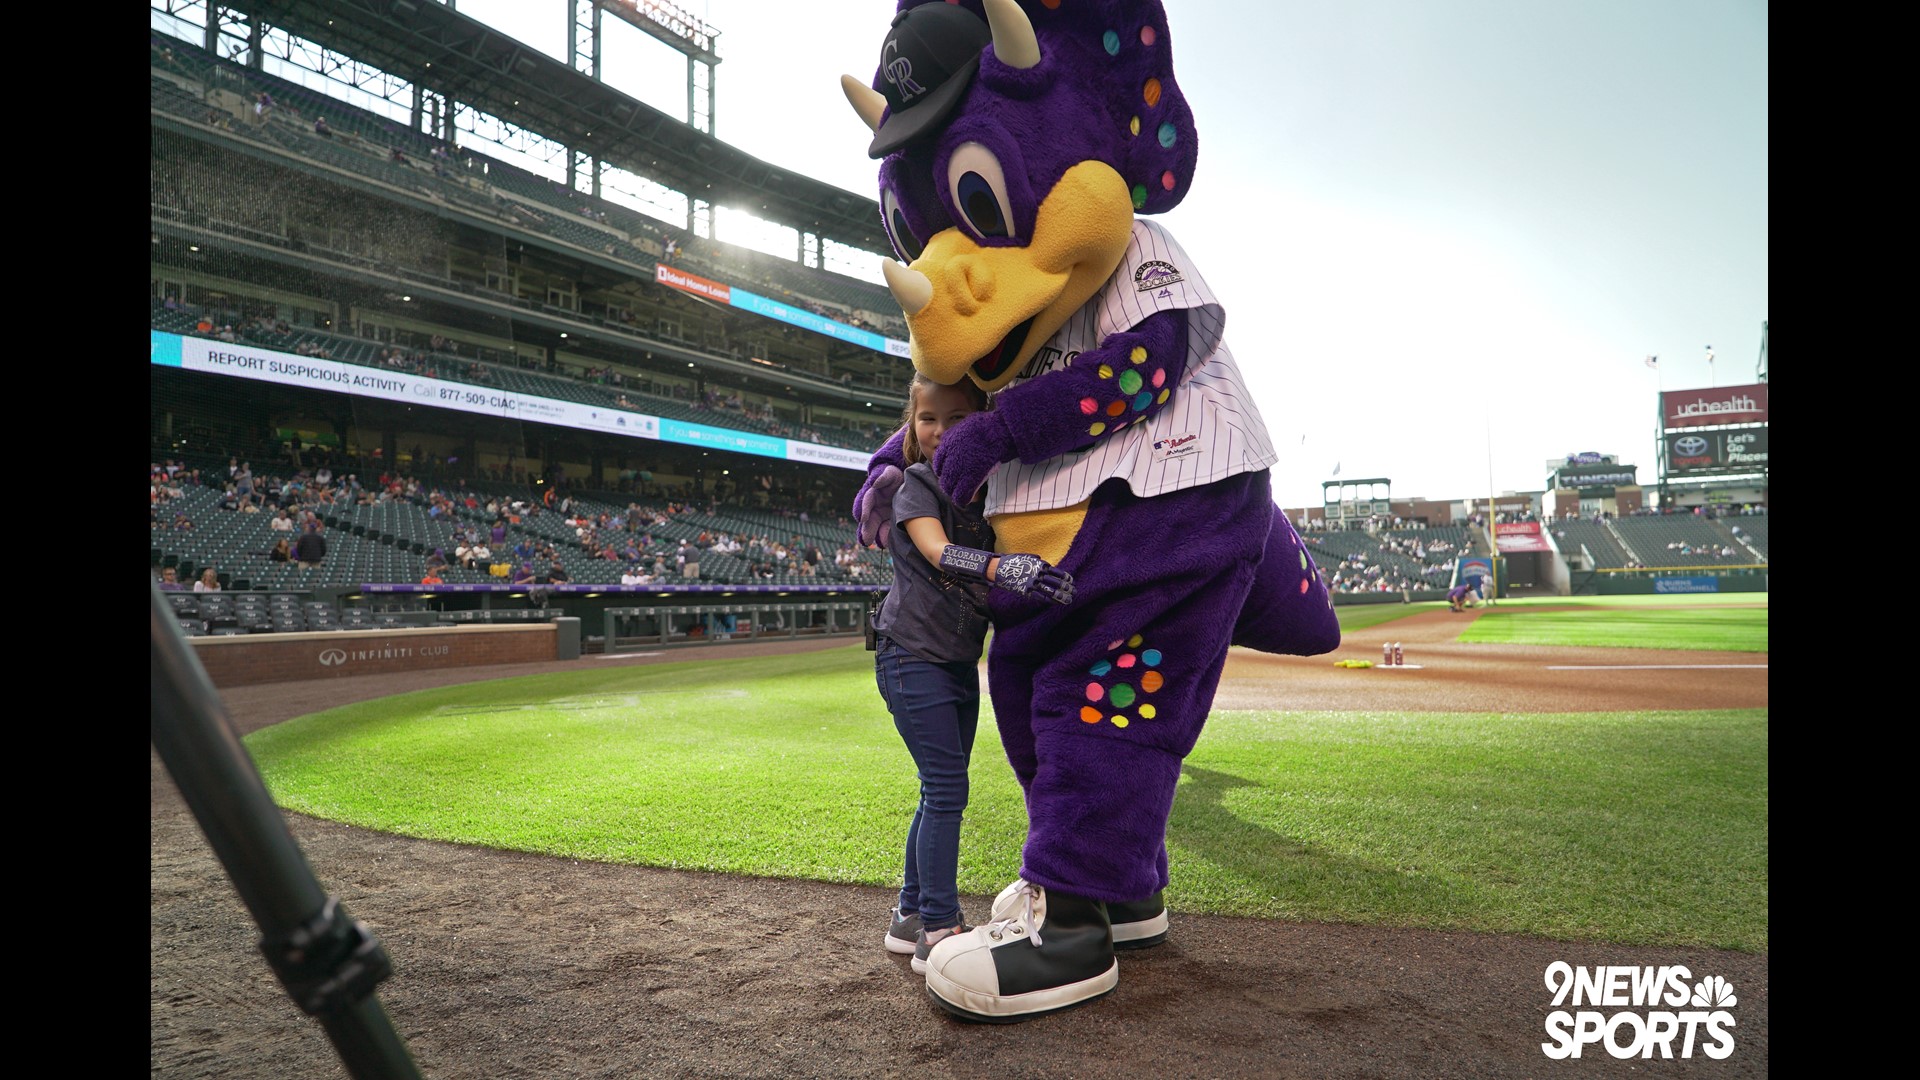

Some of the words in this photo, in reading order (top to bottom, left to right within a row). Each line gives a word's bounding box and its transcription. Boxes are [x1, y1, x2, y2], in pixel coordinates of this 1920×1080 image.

[1136, 261, 1176, 279] COLORADO
[666, 268, 686, 287] Ideal
[686, 277, 708, 294] Home
[708, 283, 730, 300] Loans
[1137, 272, 1182, 290] ROCKIES
[208, 350, 267, 370] REPORT
[269, 361, 350, 384] SUSPICIOUS
[353, 375, 406, 393] ACTIVITY
[413, 383, 437, 398] Call
[440, 387, 516, 410] 877-509-CIAC
[1677, 395, 1756, 416] uchealth
[1727, 434, 1756, 443] Let's
[1727, 444, 1745, 453] Go
[1674, 456, 1712, 465] TOYOTA
[1560, 473, 1634, 484] TUNDRA
[942, 547, 987, 563] COLORADO
[944, 556, 979, 571] ROCKIES
[352, 648, 412, 661] INFINITI
[420, 646, 449, 656] CLUB
